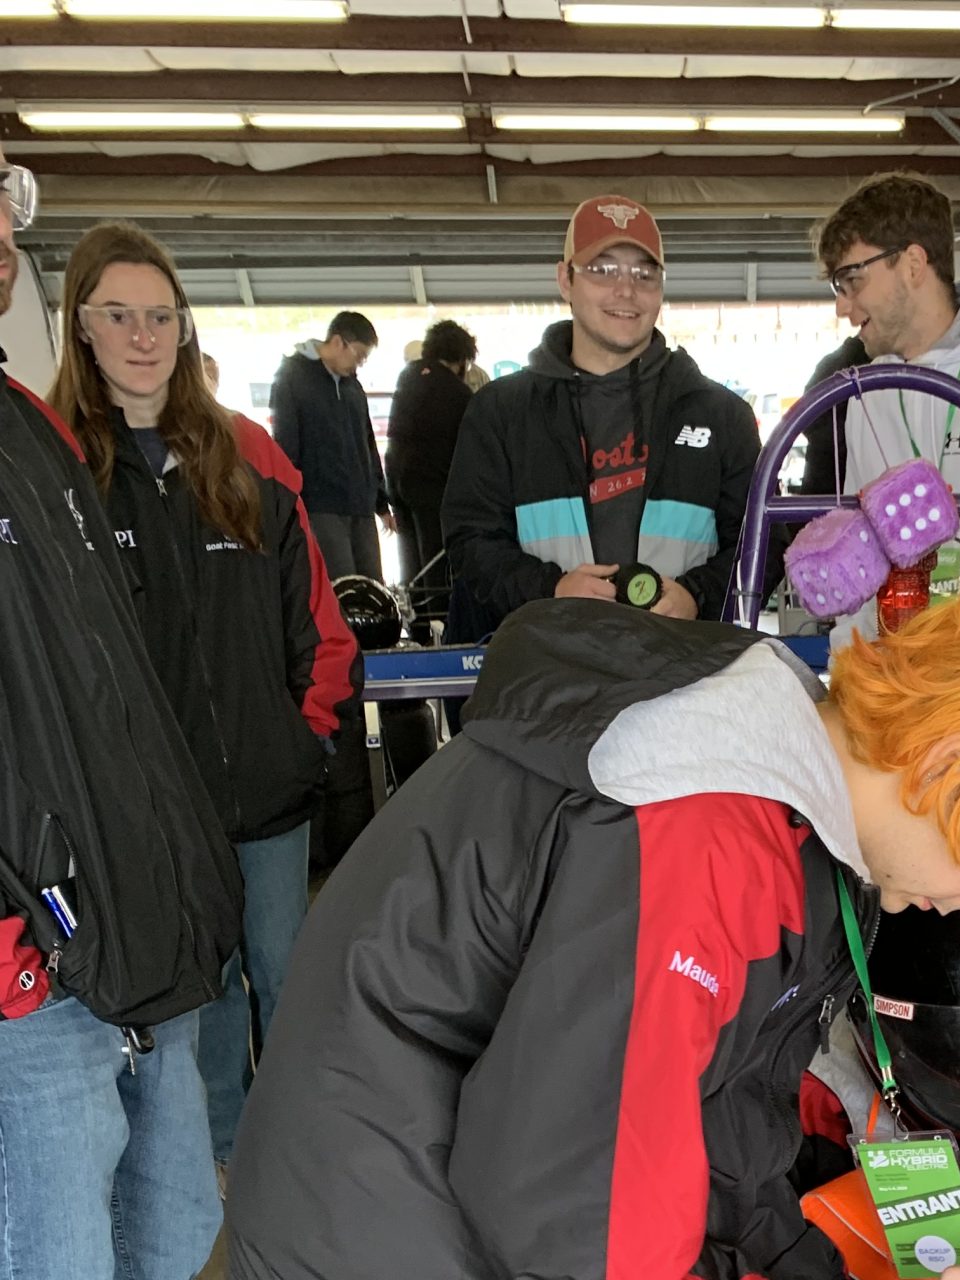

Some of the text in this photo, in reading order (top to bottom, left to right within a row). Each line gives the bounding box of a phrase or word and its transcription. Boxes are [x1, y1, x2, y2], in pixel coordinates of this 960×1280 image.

[607, 476, 633, 493] 26.2
[875, 999, 911, 1018] SIMPSON
[889, 1147, 946, 1157] FORMULA
[890, 1154, 949, 1167] HYBRID
